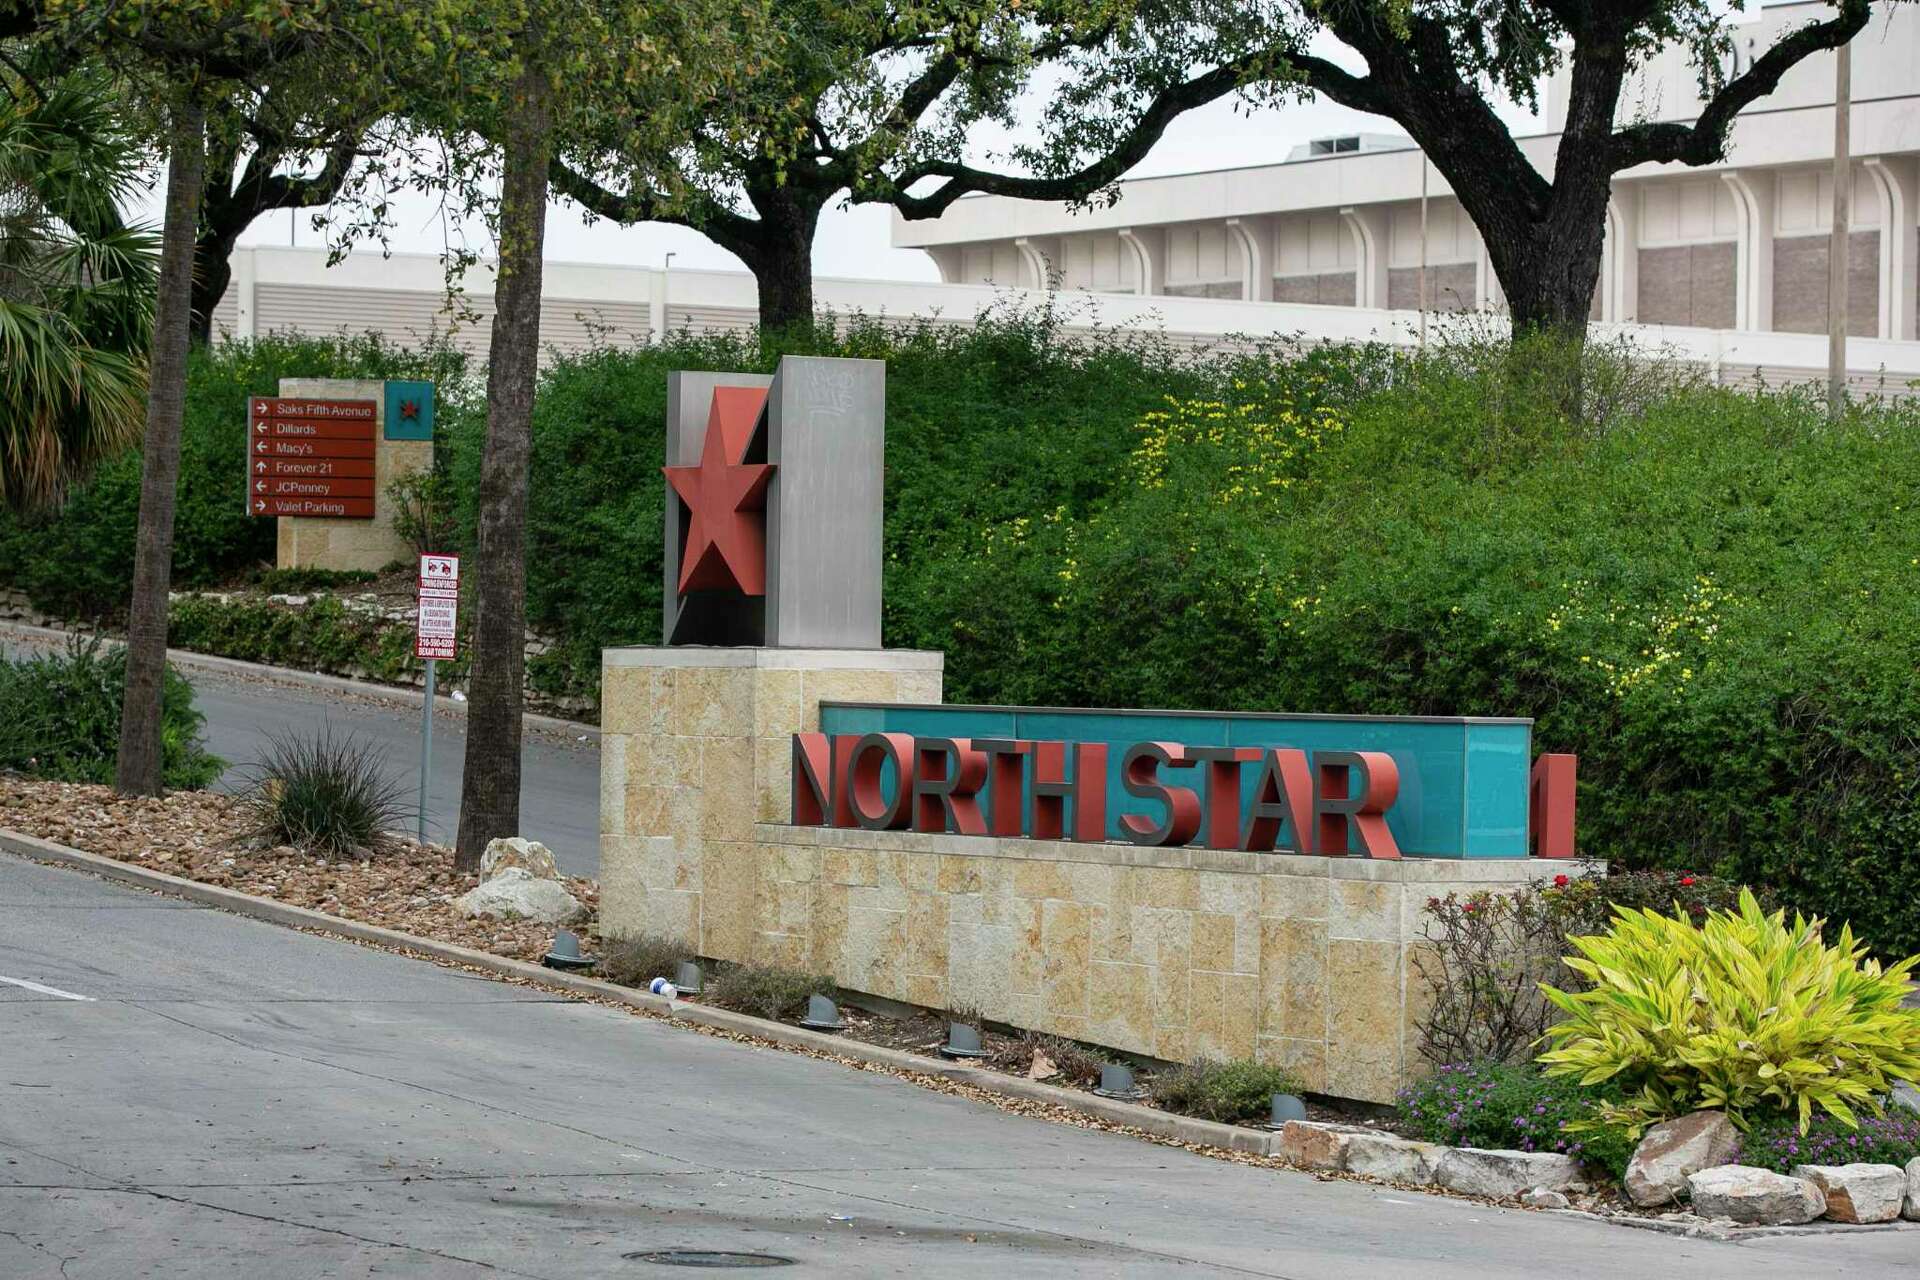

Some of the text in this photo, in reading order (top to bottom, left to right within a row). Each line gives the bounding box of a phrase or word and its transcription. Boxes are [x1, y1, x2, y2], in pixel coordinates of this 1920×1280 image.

[277, 403, 371, 416] Saks Fifth Avenue
[276, 423, 316, 434] Dillards
[276, 442, 313, 456] Macy's
[276, 462, 332, 474] Forever 21
[275, 481, 330, 496] JCPenney
[275, 501, 345, 515] Valet Parking
[792, 732, 1107, 842] NORTH
[1119, 741, 1402, 859] STAR
